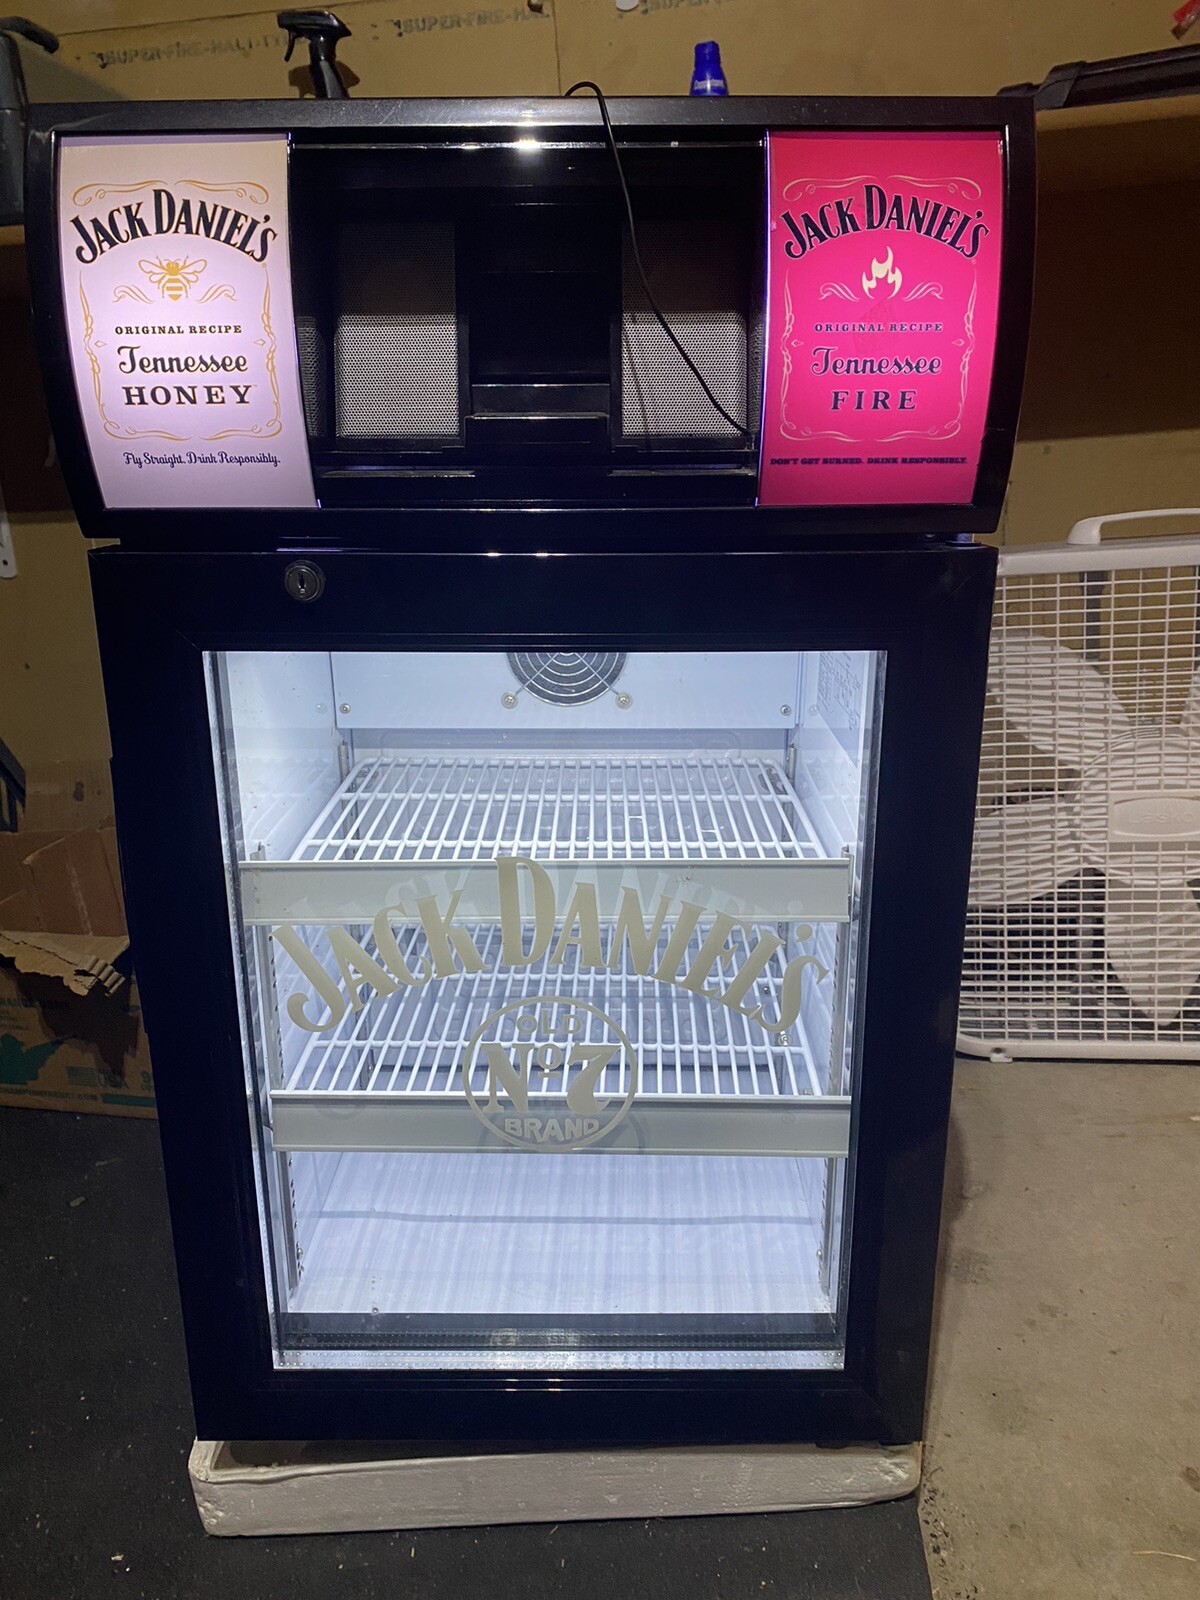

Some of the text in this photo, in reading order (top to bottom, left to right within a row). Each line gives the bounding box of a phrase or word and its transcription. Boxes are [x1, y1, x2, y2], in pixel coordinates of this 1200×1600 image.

[69, 188, 278, 264] JACK DANIEL'S
[781, 184, 990, 259] JACK DANIEL'S
[114, 324, 242, 335] ORIGINAL RECIPE
[814, 322, 943, 333] ORIGINAL RECIPE
[117, 345, 248, 374] Tennessee
[810, 345, 941, 375] Tennessee
[122, 384, 252, 406] HONEY
[830, 390, 918, 411] FIRE
[123, 450, 281, 468] Fly Straight. Drink Responsibly.
[770, 457, 799, 465] DON'T
[801, 457, 820, 465] GET
[270, 856, 830, 1034] JACK DANIEL'S
[516, 1008, 583, 1036] OLD
[504, 1117, 600, 1143] BRAND
